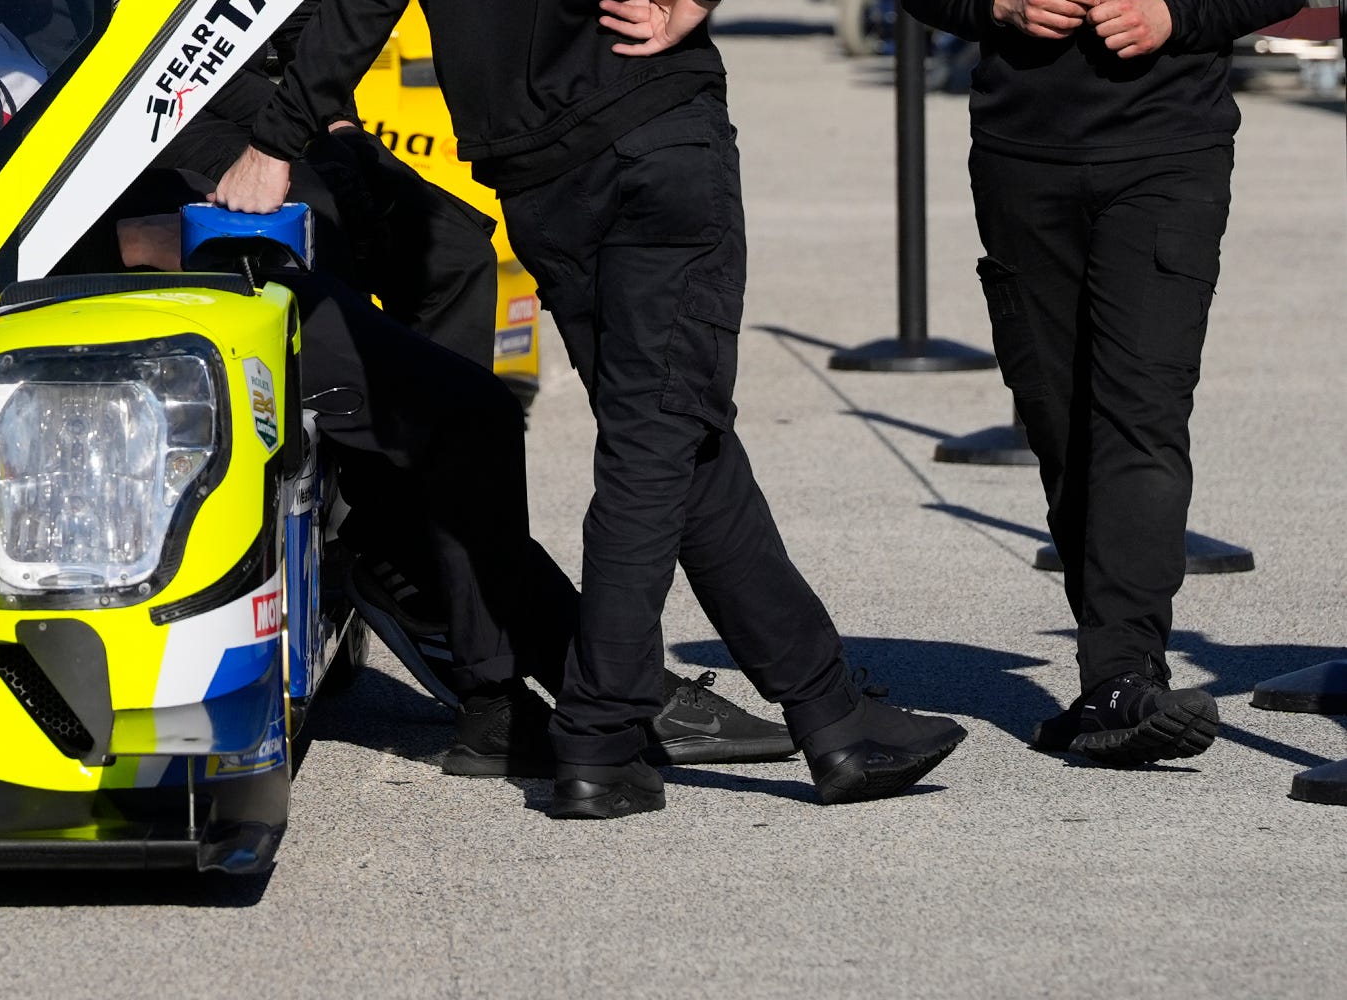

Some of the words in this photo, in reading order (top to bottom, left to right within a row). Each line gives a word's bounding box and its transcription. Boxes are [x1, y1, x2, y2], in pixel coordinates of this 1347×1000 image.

[156, 23, 215, 94] FEAR
[189, 36, 235, 86] THE
[361, 119, 435, 157] ha
[251, 375, 271, 392] ROLEX
[252, 390, 274, 418] 24
